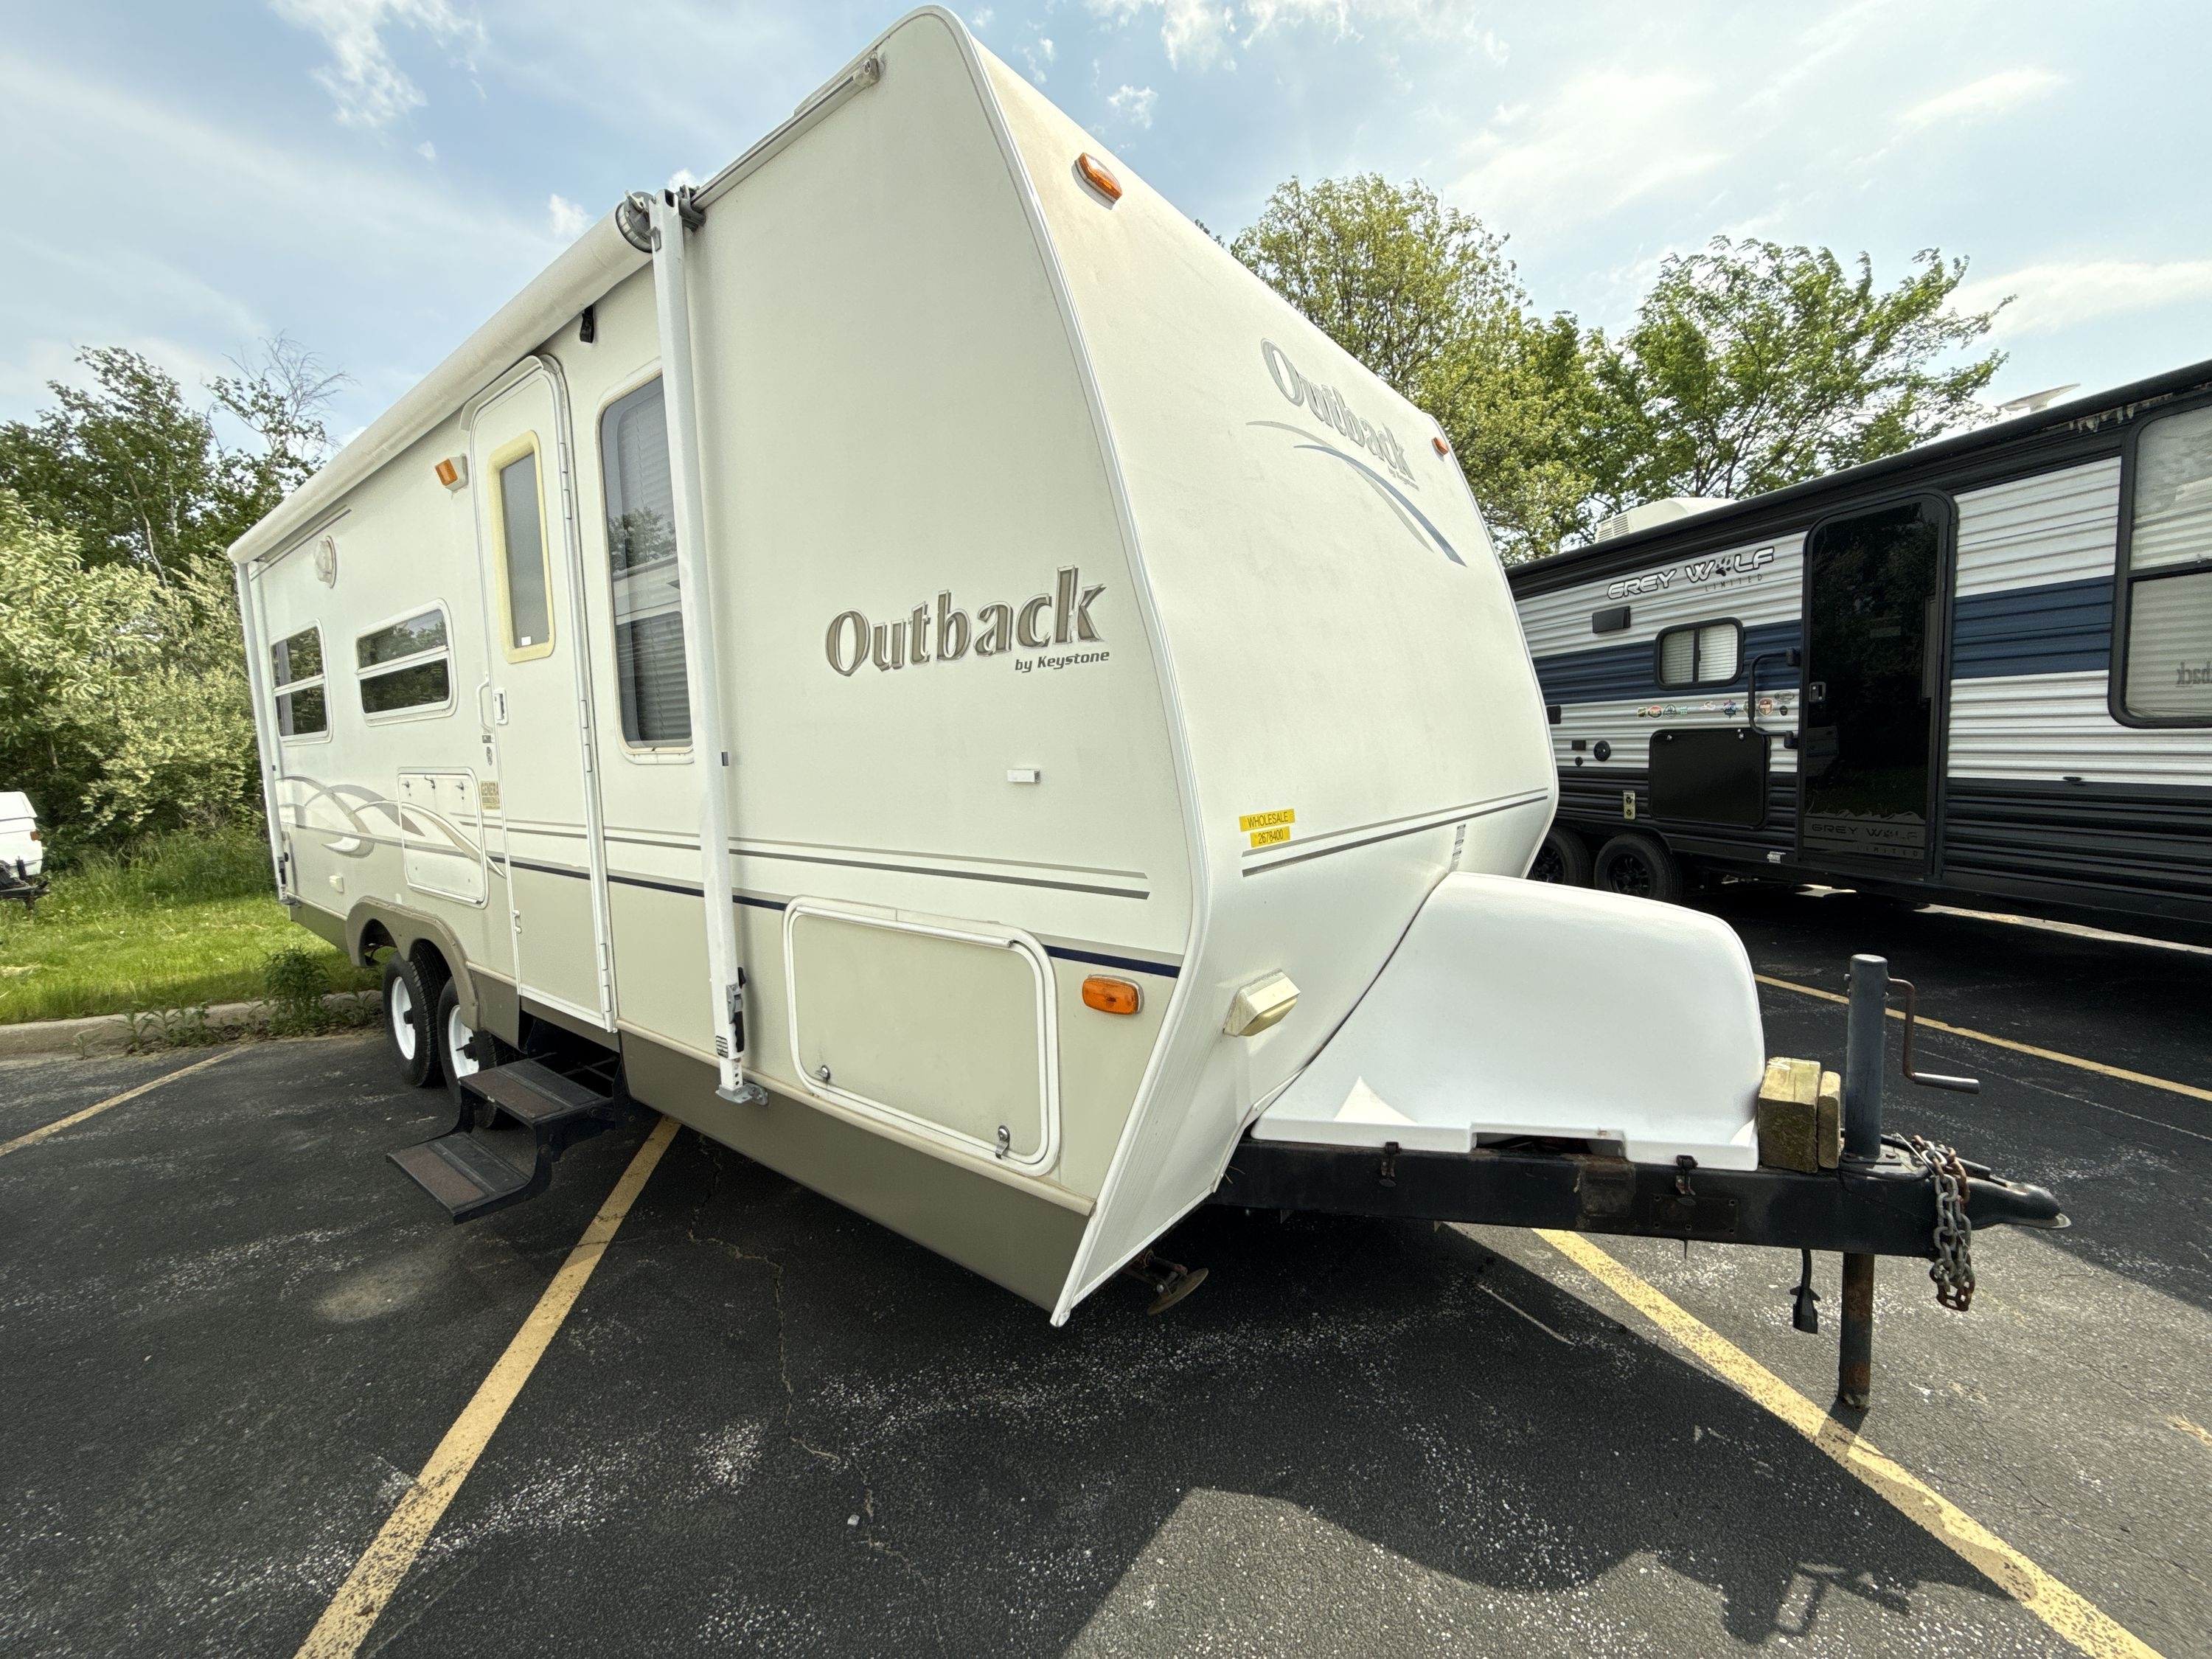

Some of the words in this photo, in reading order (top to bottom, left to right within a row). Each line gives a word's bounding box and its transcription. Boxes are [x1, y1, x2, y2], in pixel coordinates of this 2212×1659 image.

[1260, 338, 1416, 481] Outback
[1607, 568, 1677, 599] GREY
[1704, 574, 1763, 592] LIMITED
[825, 565, 1107, 676] Outback
[1015, 658, 1032, 673] by
[1037, 652, 1110, 670] Keystone
[1248, 811, 1289, 828] WHOLESALE
[1258, 829, 1284, 844] 2678400
[1812, 824, 1859, 835] GREY
